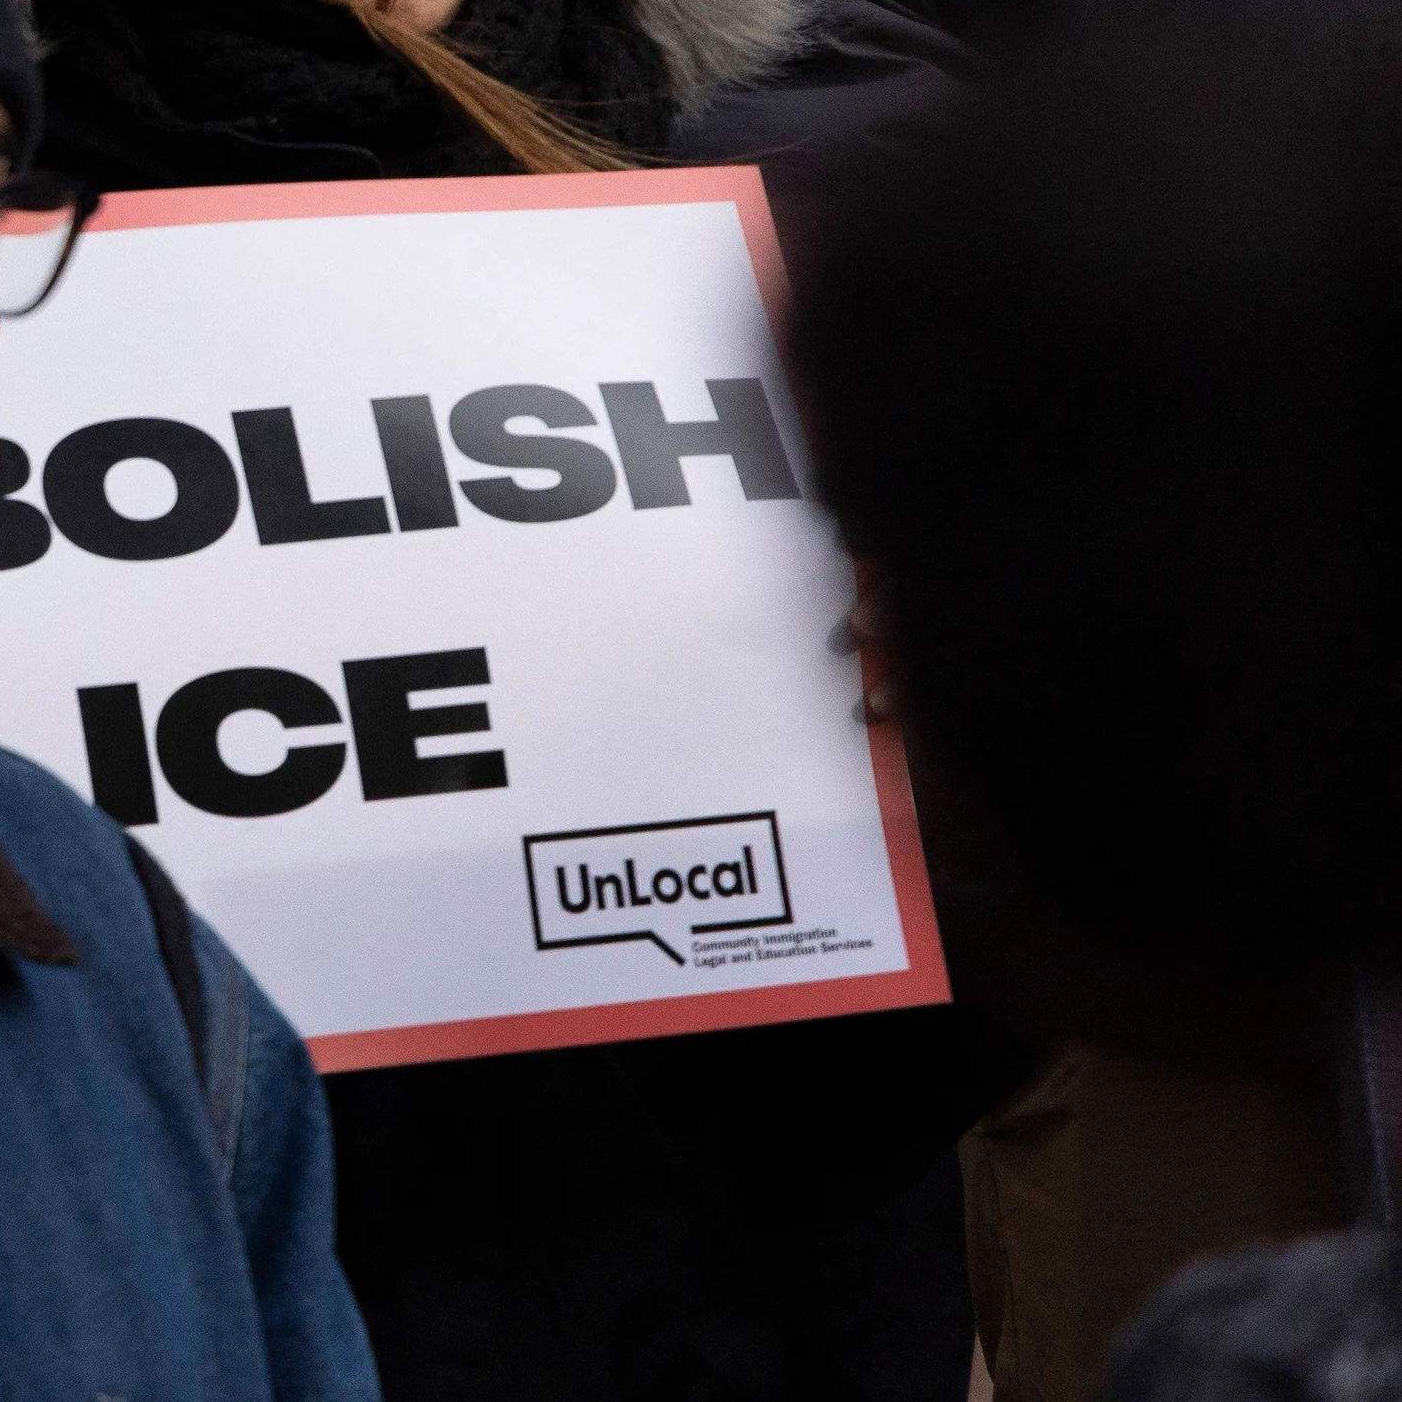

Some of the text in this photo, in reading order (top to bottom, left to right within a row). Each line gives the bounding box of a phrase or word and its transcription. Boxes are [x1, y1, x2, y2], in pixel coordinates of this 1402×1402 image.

[76, 647, 509, 827] ICE
[556, 845, 758, 915] UnLocal
[692, 936, 759, 953] Community
